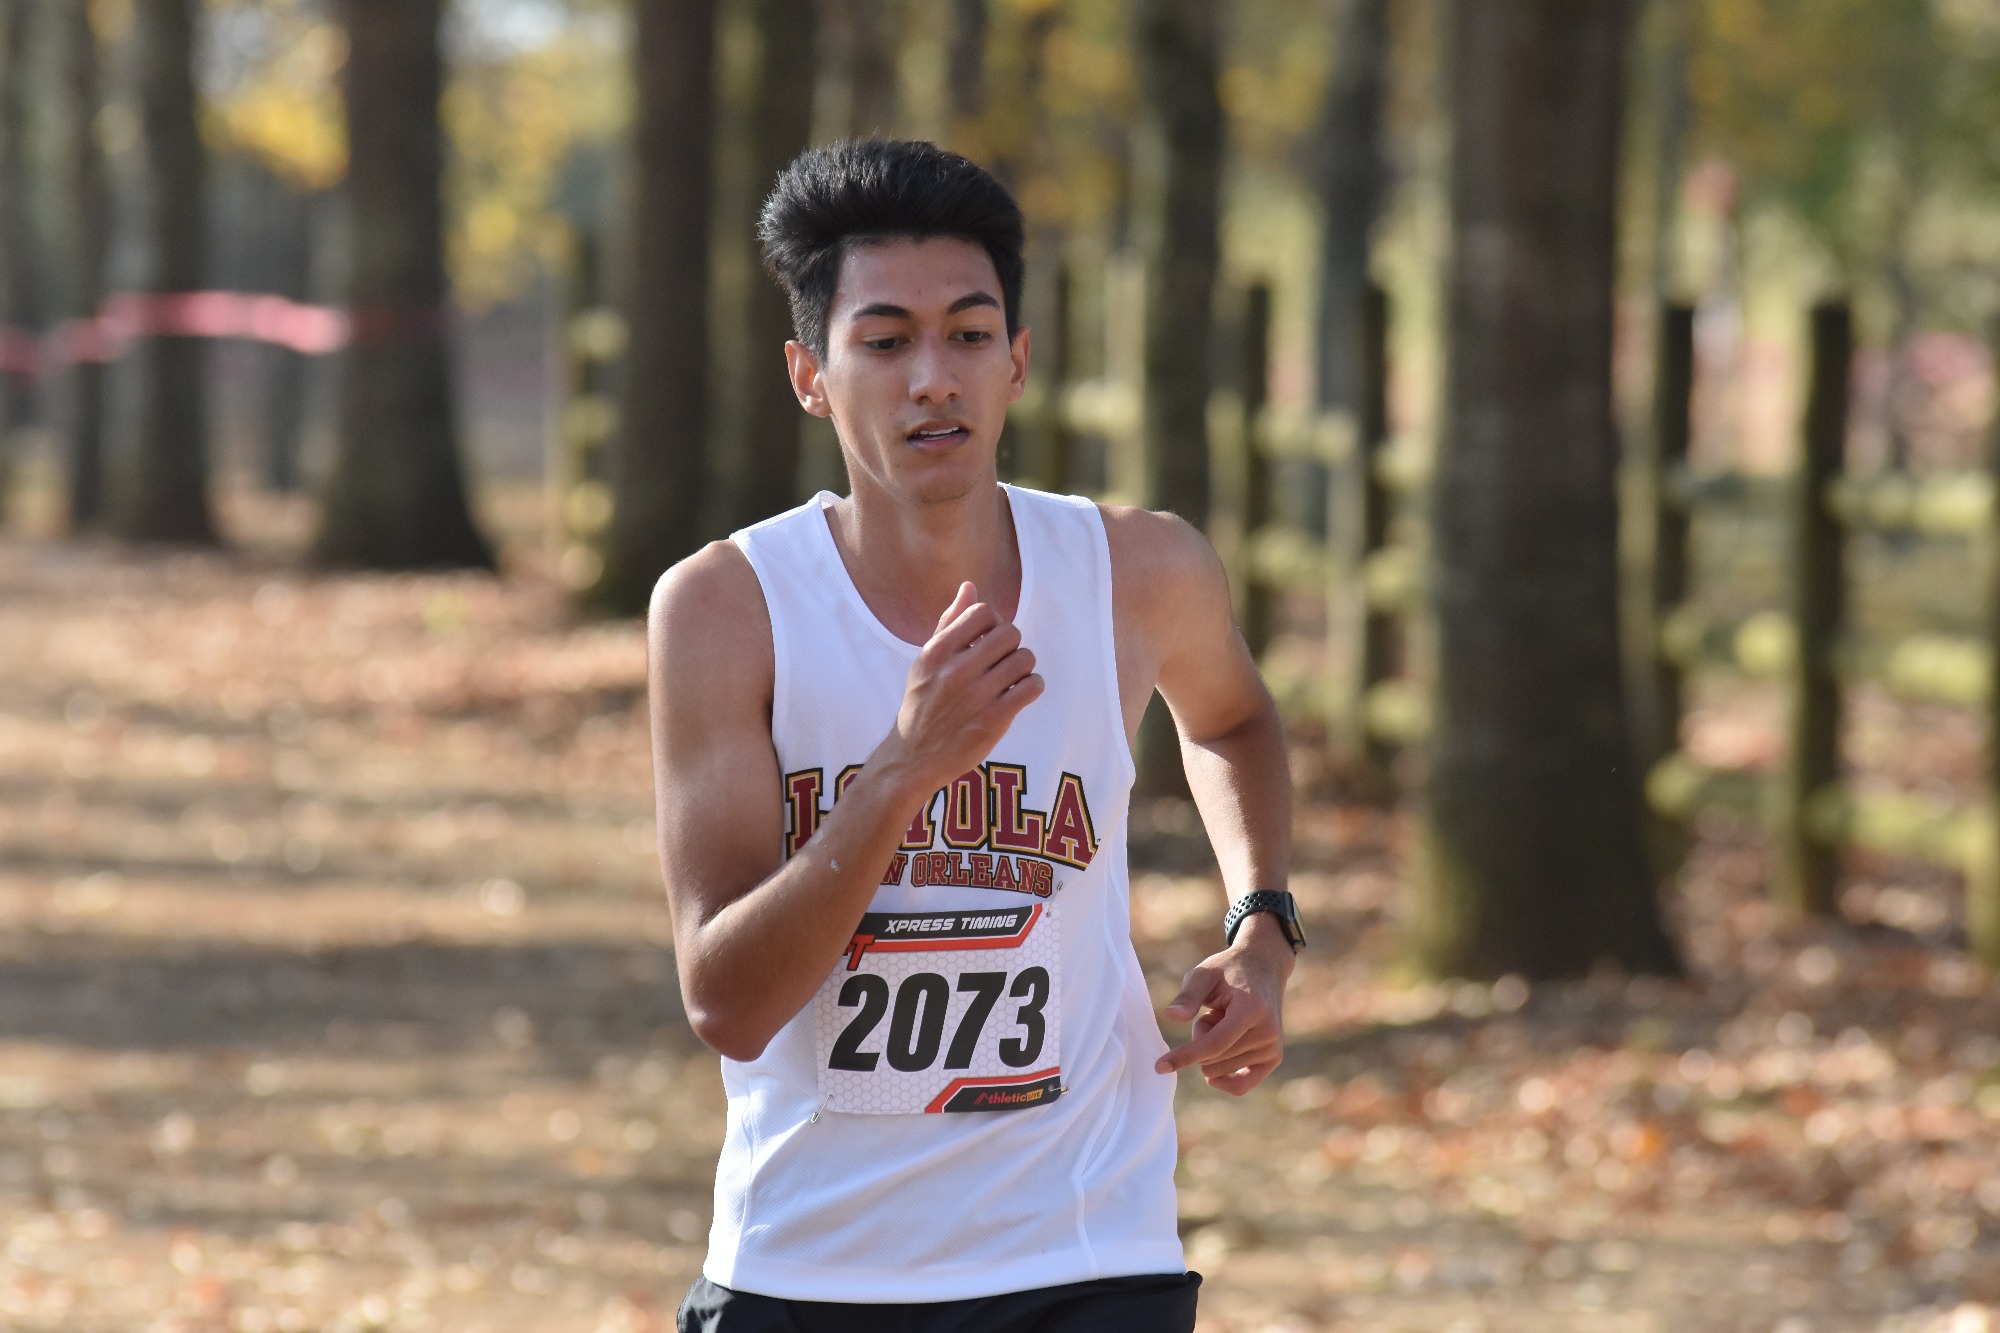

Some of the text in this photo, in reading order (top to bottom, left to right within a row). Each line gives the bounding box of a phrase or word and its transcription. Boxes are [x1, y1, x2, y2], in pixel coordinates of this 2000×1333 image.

[785, 761, 1099, 871] LOLA
[911, 852, 1054, 898] ORLEANS
[885, 914, 1018, 934] XPRESS TIMING
[828, 966, 1050, 1072] 2073
